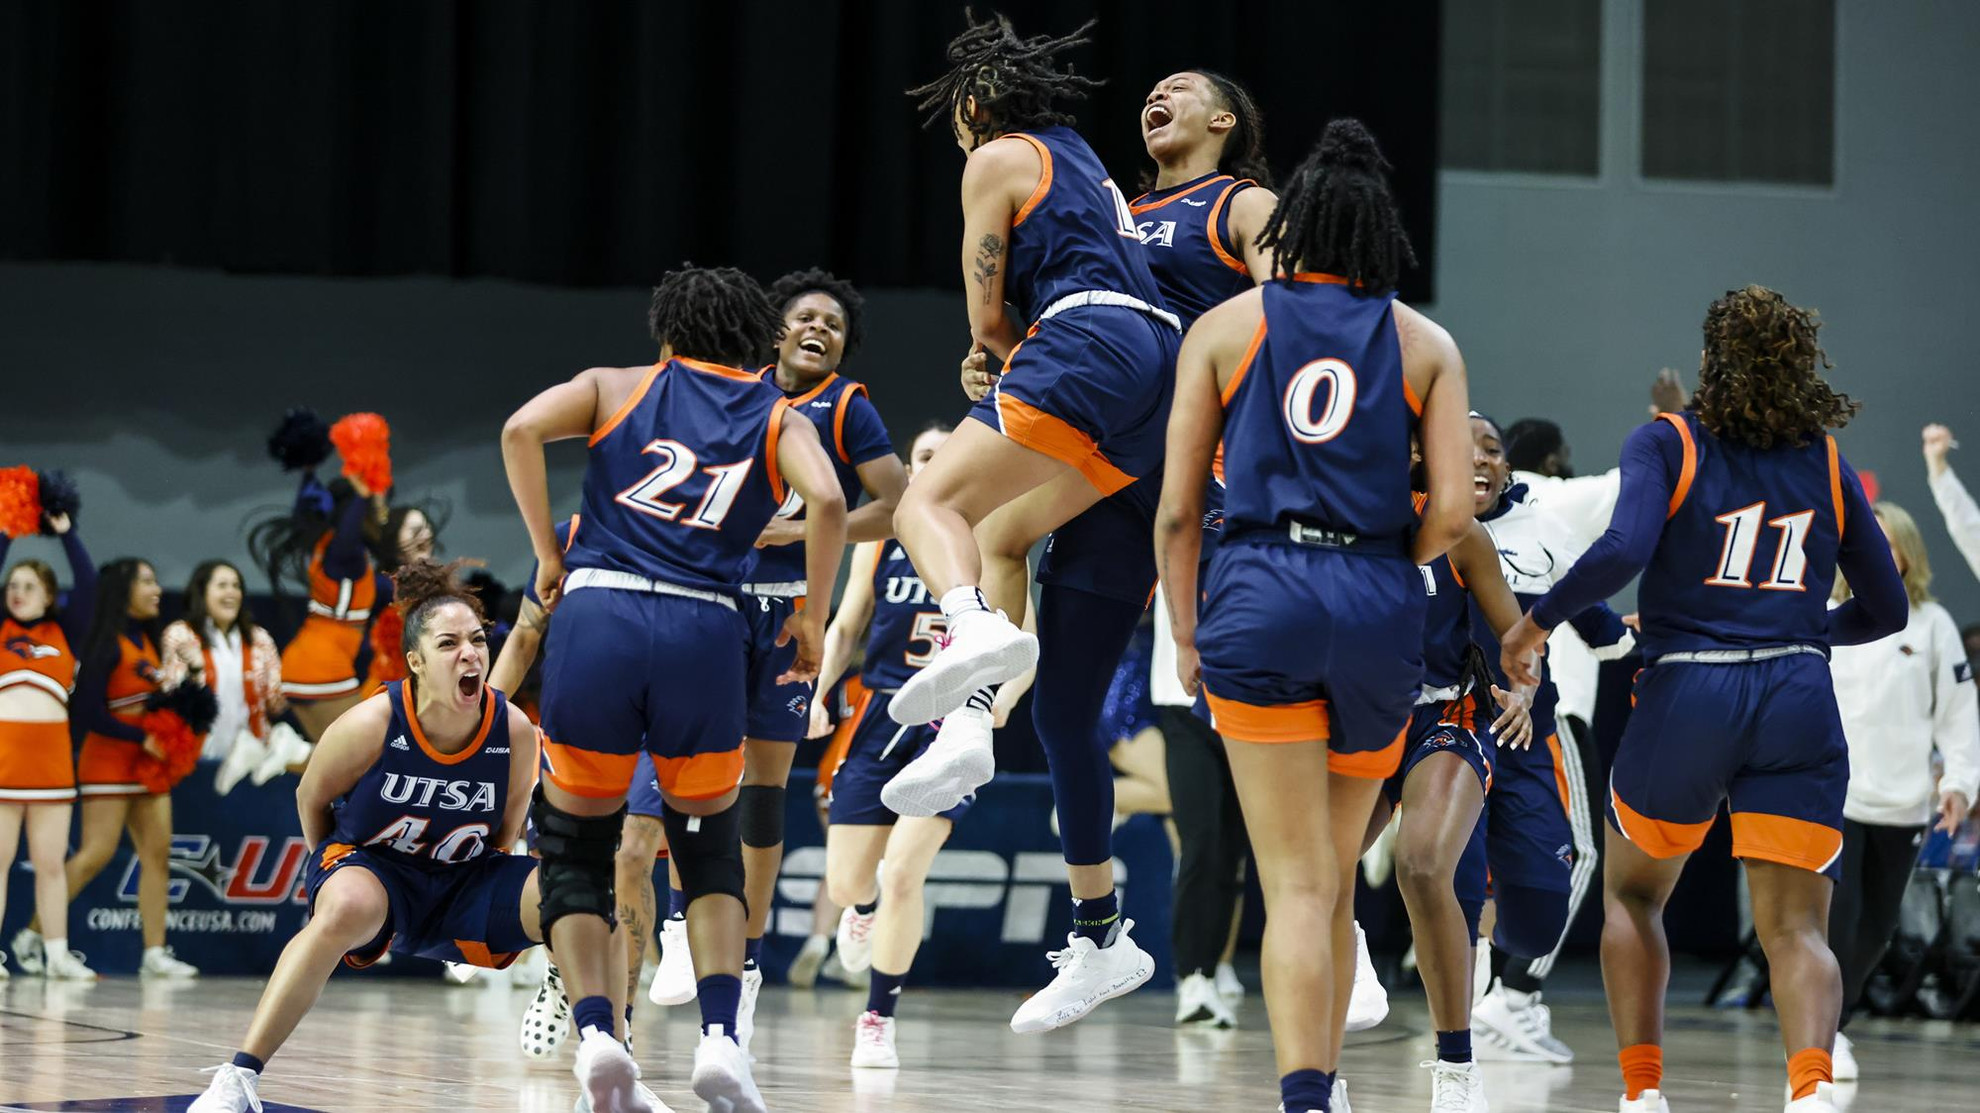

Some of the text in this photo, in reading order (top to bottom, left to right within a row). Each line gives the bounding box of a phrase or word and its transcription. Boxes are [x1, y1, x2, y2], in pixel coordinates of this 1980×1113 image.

[1136, 221, 1177, 248] SA
[1283, 357, 1358, 444] 0
[615, 438, 754, 531] 21
[1704, 501, 1815, 592] 11
[904, 611, 948, 668] 5
[380, 772, 496, 812] UTSA
[361, 814, 490, 864] 40
[87, 907, 277, 933] CONFENCEUSA.COM
